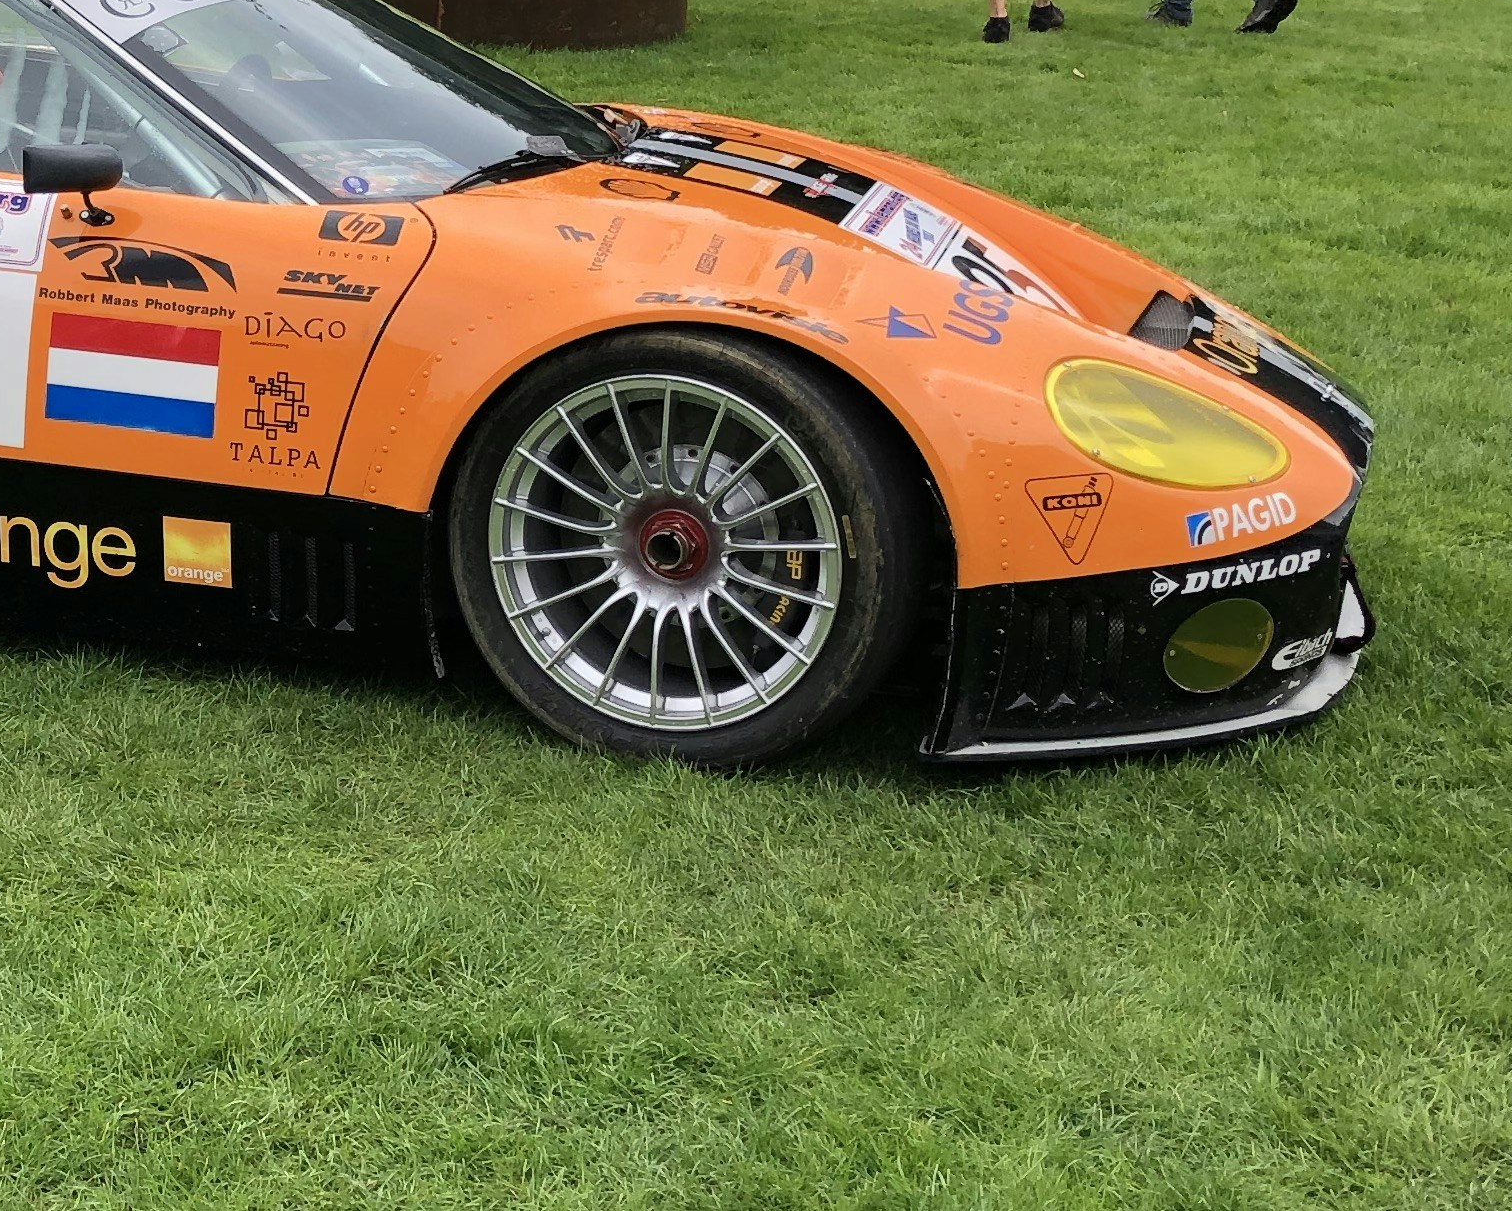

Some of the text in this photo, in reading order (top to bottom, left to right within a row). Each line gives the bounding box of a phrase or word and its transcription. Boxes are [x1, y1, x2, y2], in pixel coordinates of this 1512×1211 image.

[343, 212, 381, 243] hp
[317, 248, 391, 263] invent
[39, 287, 236, 319] Robbert Maas Photography
[943, 279, 1014, 345] UGS
[229, 441, 321, 470] TALPA
[1045, 493, 1100, 510] KONI
[1212, 492, 1297, 541] PAGID
[167, 565, 224, 584] orange
[1181, 549, 1322, 595] DUNLOP
[1272, 628, 1333, 670] Eibach
